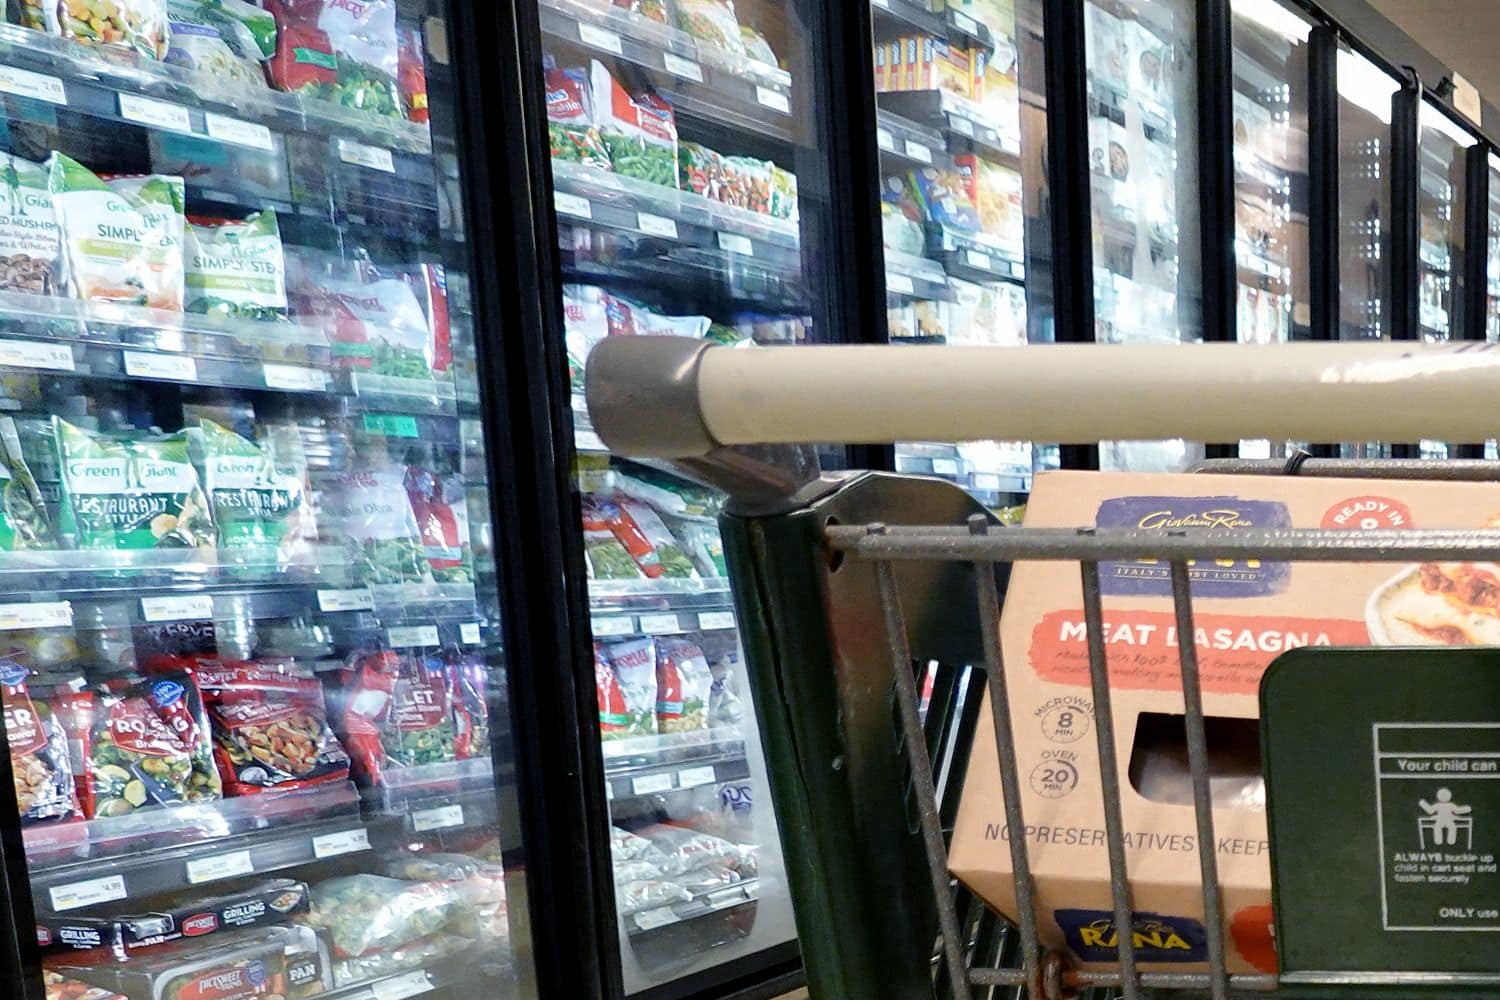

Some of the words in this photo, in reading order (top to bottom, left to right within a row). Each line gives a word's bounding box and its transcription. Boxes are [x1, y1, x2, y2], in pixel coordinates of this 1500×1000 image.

[25, 194, 54, 208] Gia
[98, 223, 144, 243] SIMPL
[1139, 510, 1211, 530] Giovanni
[1202, 508, 1254, 530] Rana
[1333, 499, 1384, 527] READY
[1387, 507, 1405, 528] IN
[1057, 712, 1074, 727] 8
[1055, 728, 1074, 737] MIN
[1041, 749, 1078, 762] OVEN
[1398, 759, 1430, 772] Your
[1433, 758, 1468, 772] child
[1472, 761, 1497, 772] can
[1040, 769, 1070, 784] 20
[1043, 784, 1063, 792] MIN
[1022, 826, 1195, 852] PRESERATIVES
[1217, 837, 1270, 856] KEEP
[1395, 853, 1443, 864] ALWAYS
[223, 900, 266, 921] GRILLING
[1438, 907, 1475, 919] ONLY
[1477, 909, 1499, 919] use
[289, 964, 316, 982] PAN
